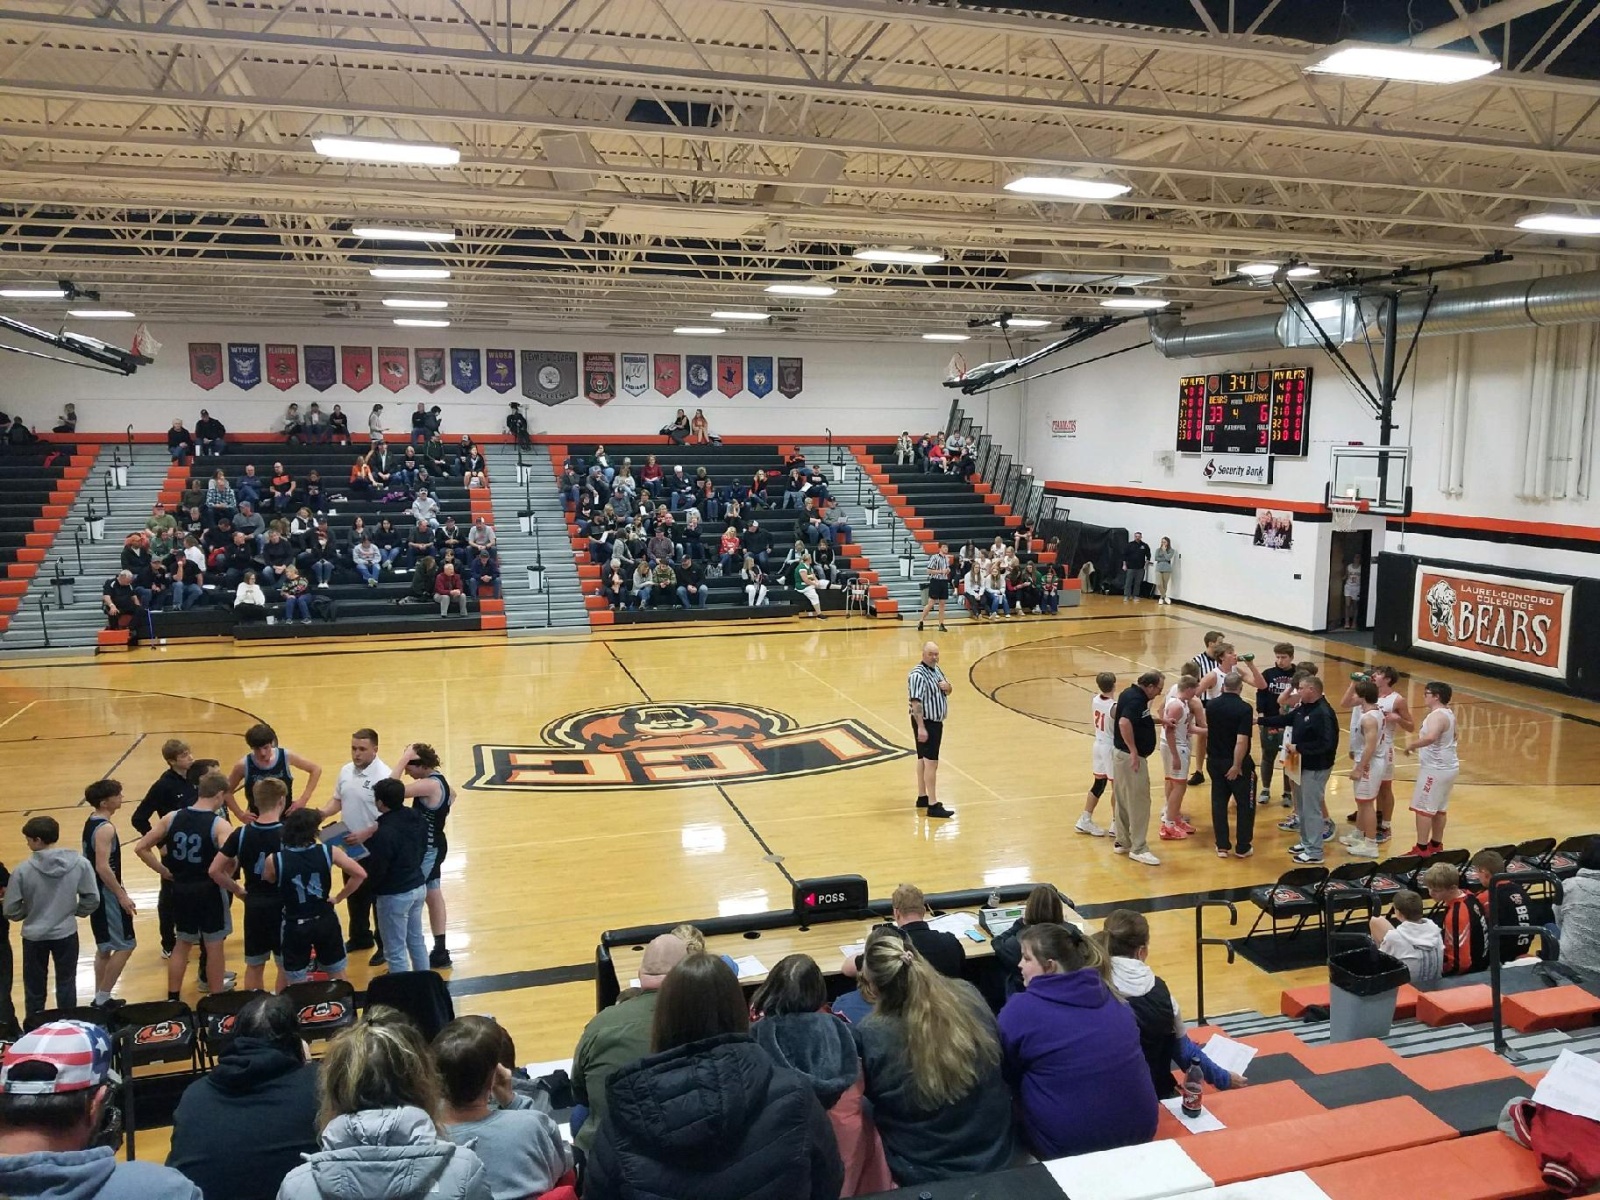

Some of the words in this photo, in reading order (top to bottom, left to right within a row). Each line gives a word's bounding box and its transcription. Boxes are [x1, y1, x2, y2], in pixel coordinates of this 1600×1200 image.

[1293, 370, 1305, 379] PTS
[1279, 383, 1284, 391] 4
[1276, 395, 1284, 403] 14
[1209, 406, 1223, 423] 33
[1232, 408, 1239, 419] 4
[1260, 404, 1268, 422] 6
[1273, 406, 1282, 416] 31
[1180, 419, 1187, 429] 32
[1273, 418, 1282, 428] 32
[1260, 431, 1267, 445] 3
[1272, 430, 1281, 440] 33
[1218, 465, 1244, 477] Security
[1246, 466, 1264, 477] Bank
[1476, 595, 1534, 611] COLERIDGE
[1458, 601, 1552, 657] BEARS
[1094, 710, 1105, 732] 21
[172, 831, 202, 863] 32
[291, 872, 323, 903] 14
